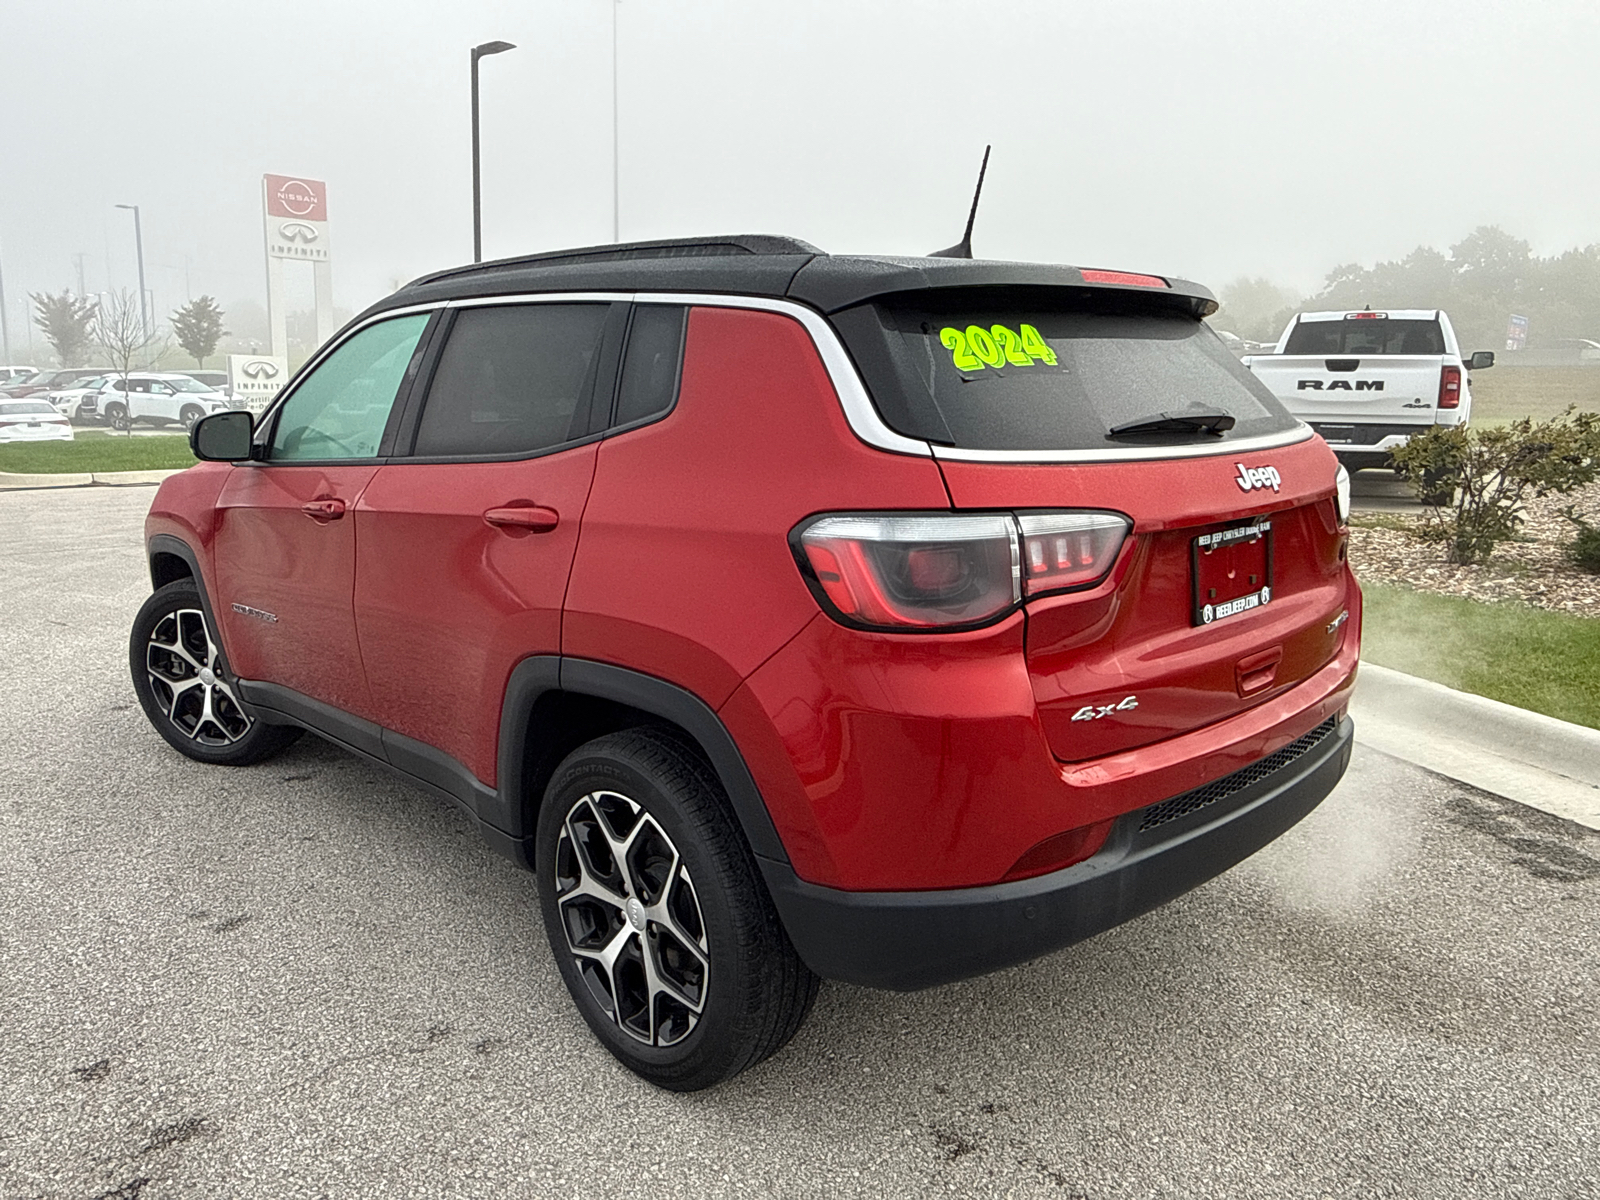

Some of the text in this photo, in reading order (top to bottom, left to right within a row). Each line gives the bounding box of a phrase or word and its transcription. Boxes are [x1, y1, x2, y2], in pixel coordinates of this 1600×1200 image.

[277, 192, 318, 203] NISSAN
[271, 244, 328, 258] INFINITI
[940, 324, 1058, 372] 2024
[1297, 379, 1385, 391] RAM
[1234, 462, 1282, 493] Jeep
[1198, 534, 1211, 546] REED
[1211, 531, 1223, 543] JEEP
[1223, 527, 1245, 541] CHRYSLER
[1216, 594, 1259, 619] REEDJEEP.COM
[1071, 695, 1139, 722] 4x4
